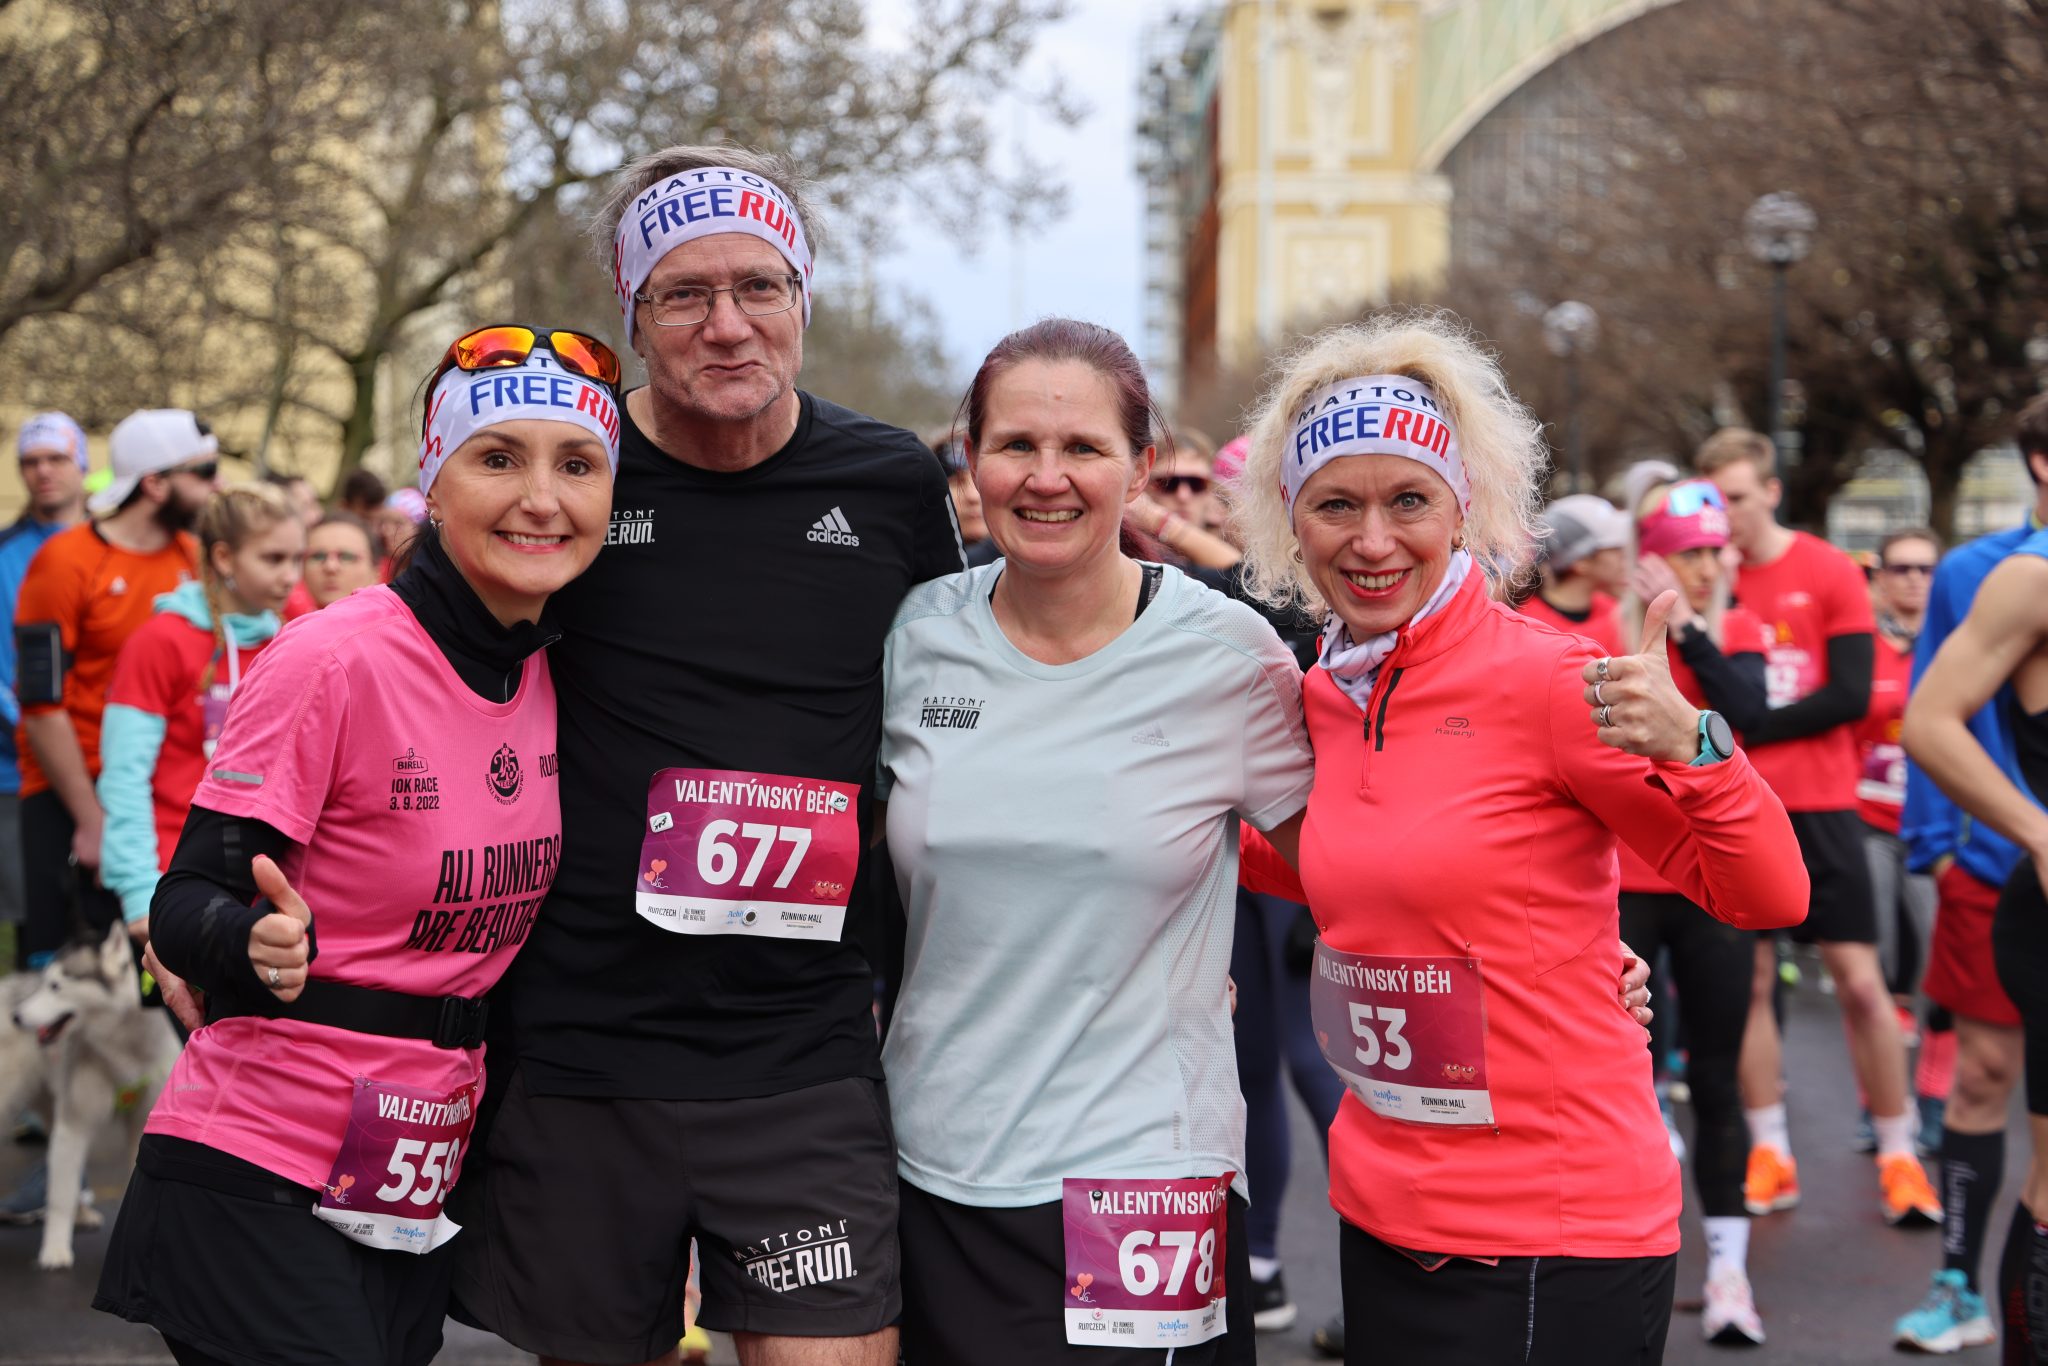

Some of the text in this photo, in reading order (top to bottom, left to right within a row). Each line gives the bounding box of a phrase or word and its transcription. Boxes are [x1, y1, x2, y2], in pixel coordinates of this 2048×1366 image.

[637, 171, 793, 215] MATTONI
[639, 188, 796, 250] FREERUN
[1298, 386, 1438, 425] MATTON
[1296, 406, 1451, 466] FREERUN
[613, 509, 652, 521] TONI
[604, 522, 653, 546] ERUN
[807, 528, 860, 547] adidas
[919, 708, 981, 730] FREERUN
[923, 696, 983, 708] MATTONI
[1131, 730, 1170, 747] adidas
[397, 760, 425, 770] BIRELL
[414, 777, 439, 793] RACE
[675, 778, 804, 812] VALENTÝNSKÝ
[390, 795, 440, 810] 3. 9. 2022
[432, 833, 560, 904] ALL RUNNERS
[697, 819, 812, 889] 677
[401, 895, 545, 954] ARE BEAUTIF
[781, 911, 823, 924] RUNNING MALL
[1318, 953, 1451, 994] VALENTÝNSKÝ BĚH
[1348, 1001, 1412, 1071] 53
[1420, 1096, 1466, 1109] RUNNING MALL
[375, 1137, 460, 1206] 559
[1088, 1184, 1216, 1215] VALENTÝNSKÝ
[734, 1219, 845, 1261] MATTONI
[1118, 1227, 1216, 1297] 678
